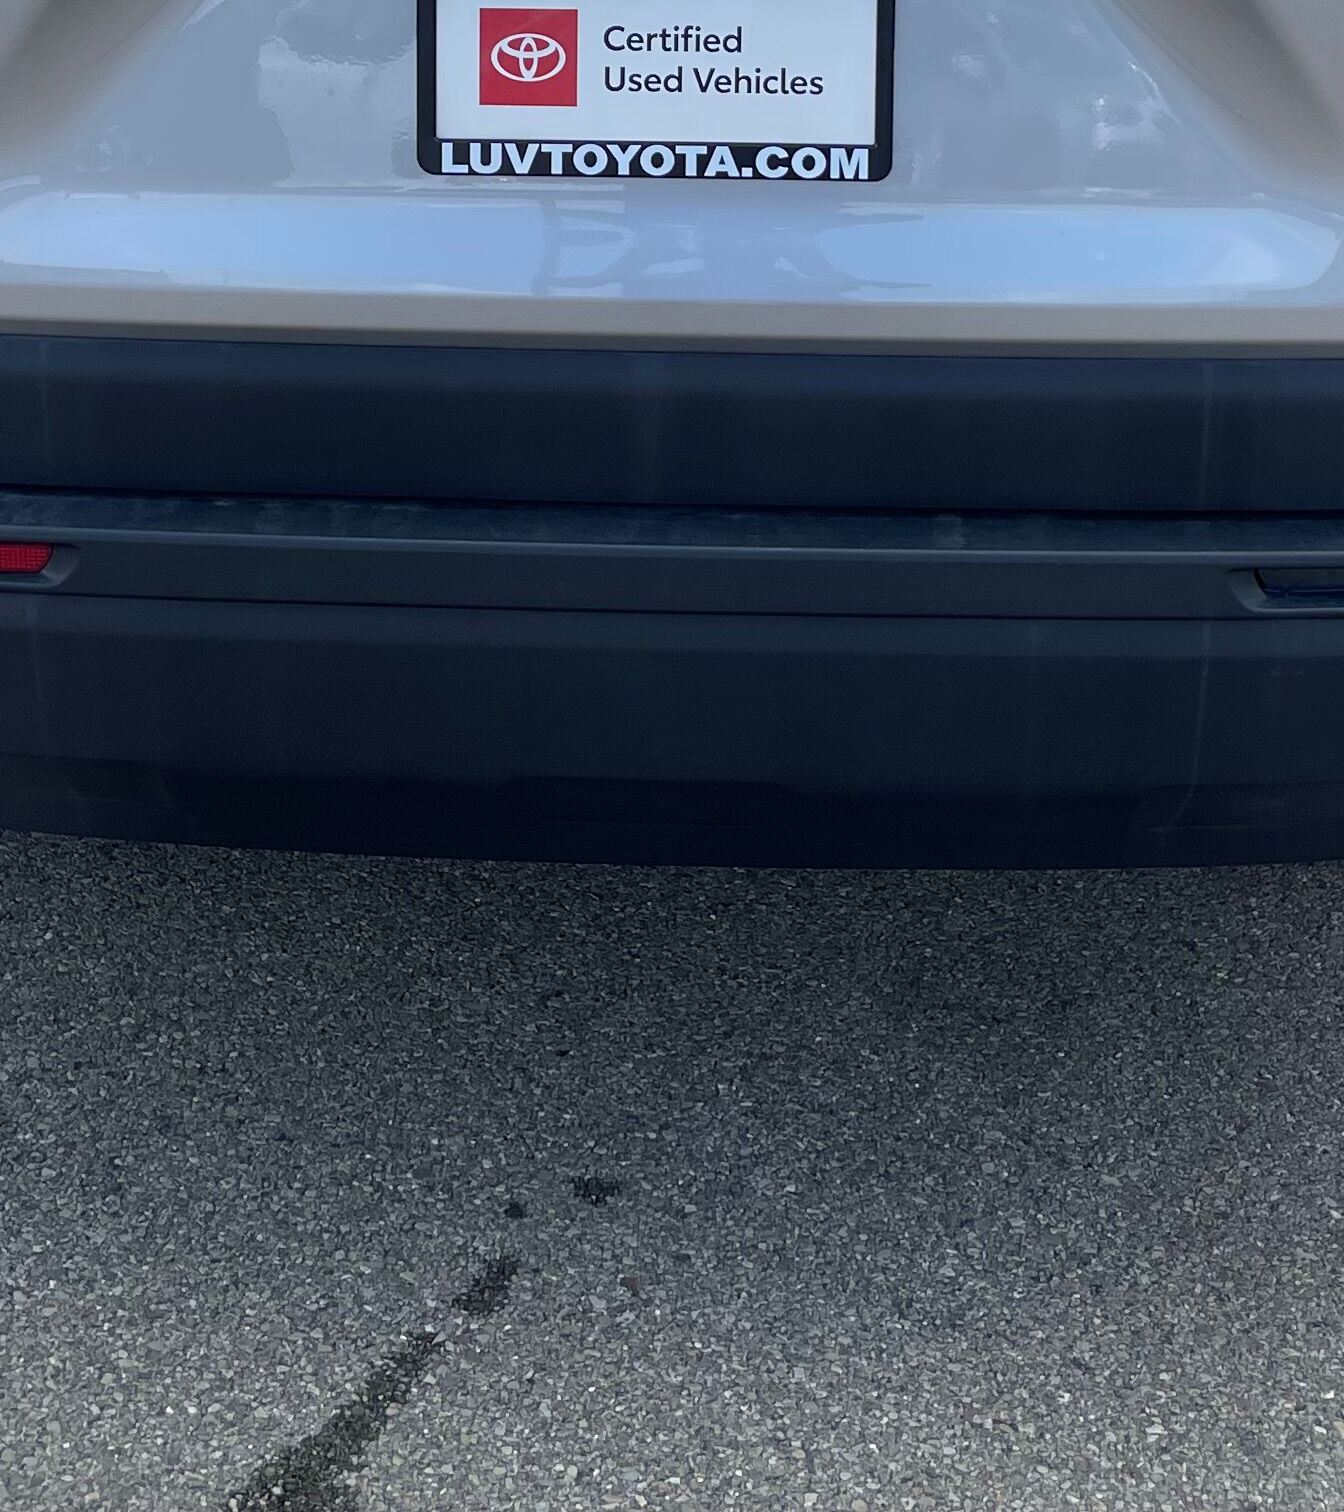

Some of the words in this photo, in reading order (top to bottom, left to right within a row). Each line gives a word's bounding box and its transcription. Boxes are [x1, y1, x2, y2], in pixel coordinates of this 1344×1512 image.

[603, 25, 743, 54] Certified
[603, 66, 683, 93] Used
[692, 67, 824, 96] Vehicles
[440, 141, 870, 180] LUVTOYOTA.COM
